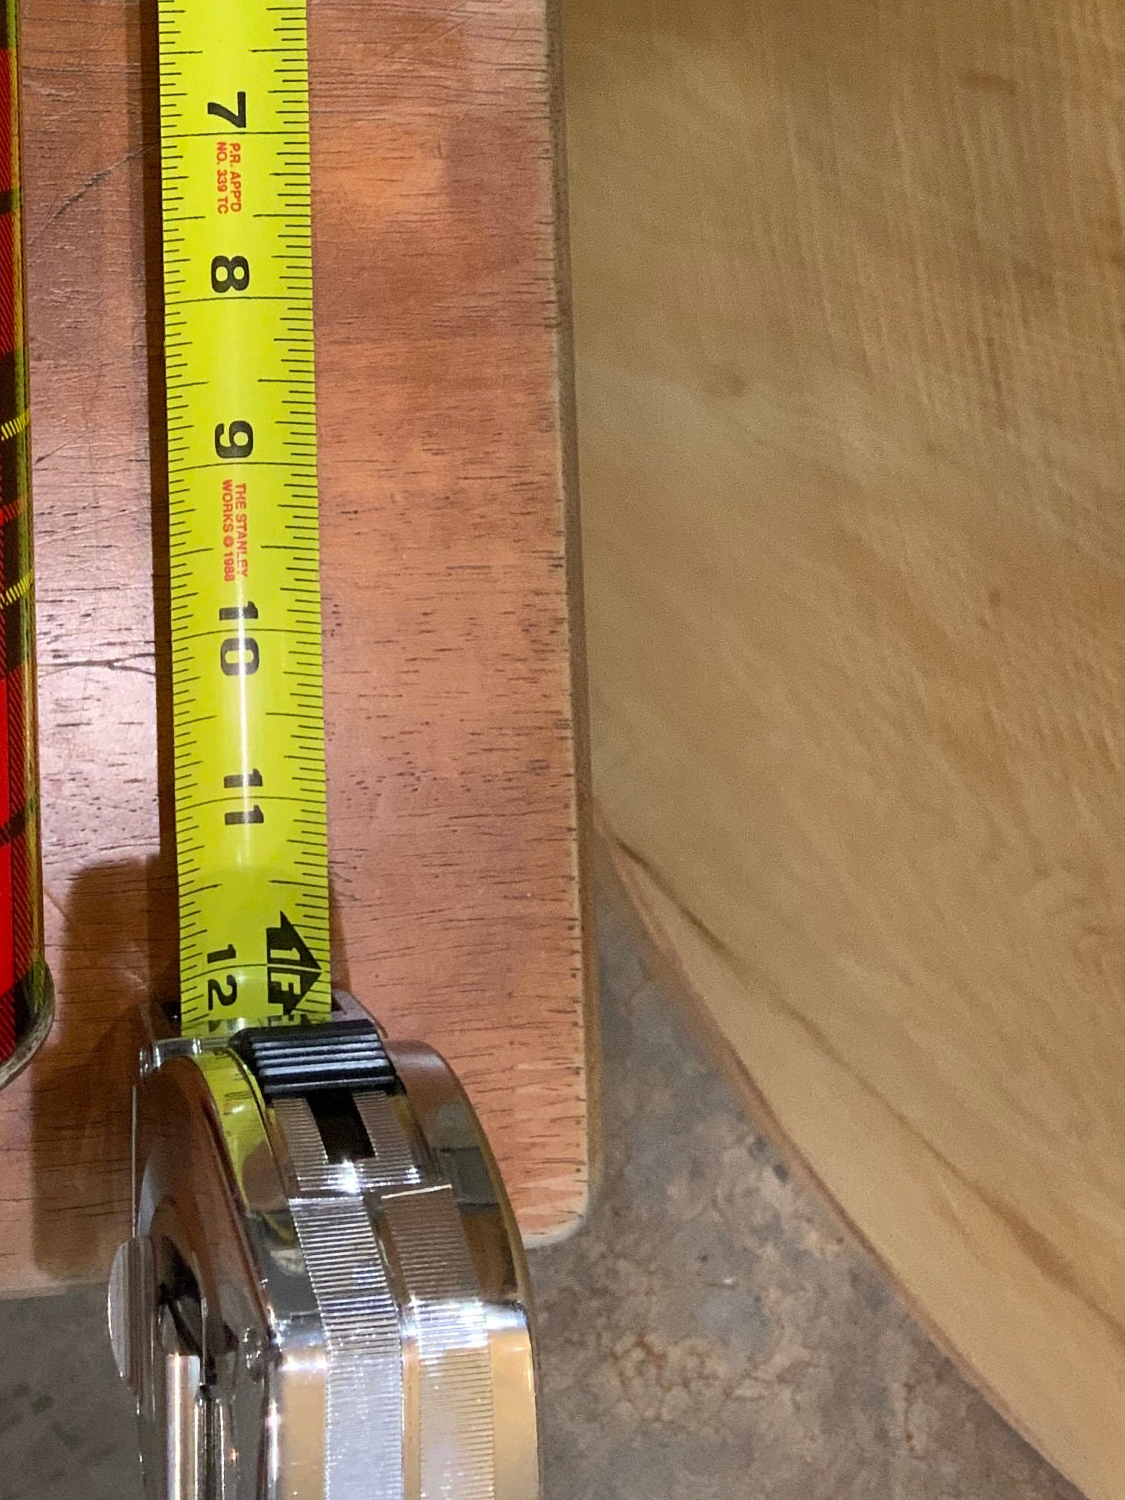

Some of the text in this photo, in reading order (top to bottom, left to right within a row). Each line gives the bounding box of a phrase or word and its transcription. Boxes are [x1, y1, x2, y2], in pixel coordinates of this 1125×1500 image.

[207, 91, 247, 128] 7
[216, 141, 228, 165] NO.
[217, 196, 228, 214] TC
[211, 255, 250, 293] 8
[214, 420, 254, 459] 9
[222, 479, 234, 533] WORKS
[235, 482, 249, 578] THE STANLEY
[219, 601, 260, 677] 10
[223, 768, 265, 826] 11
[207, 943, 238, 1011] 12
